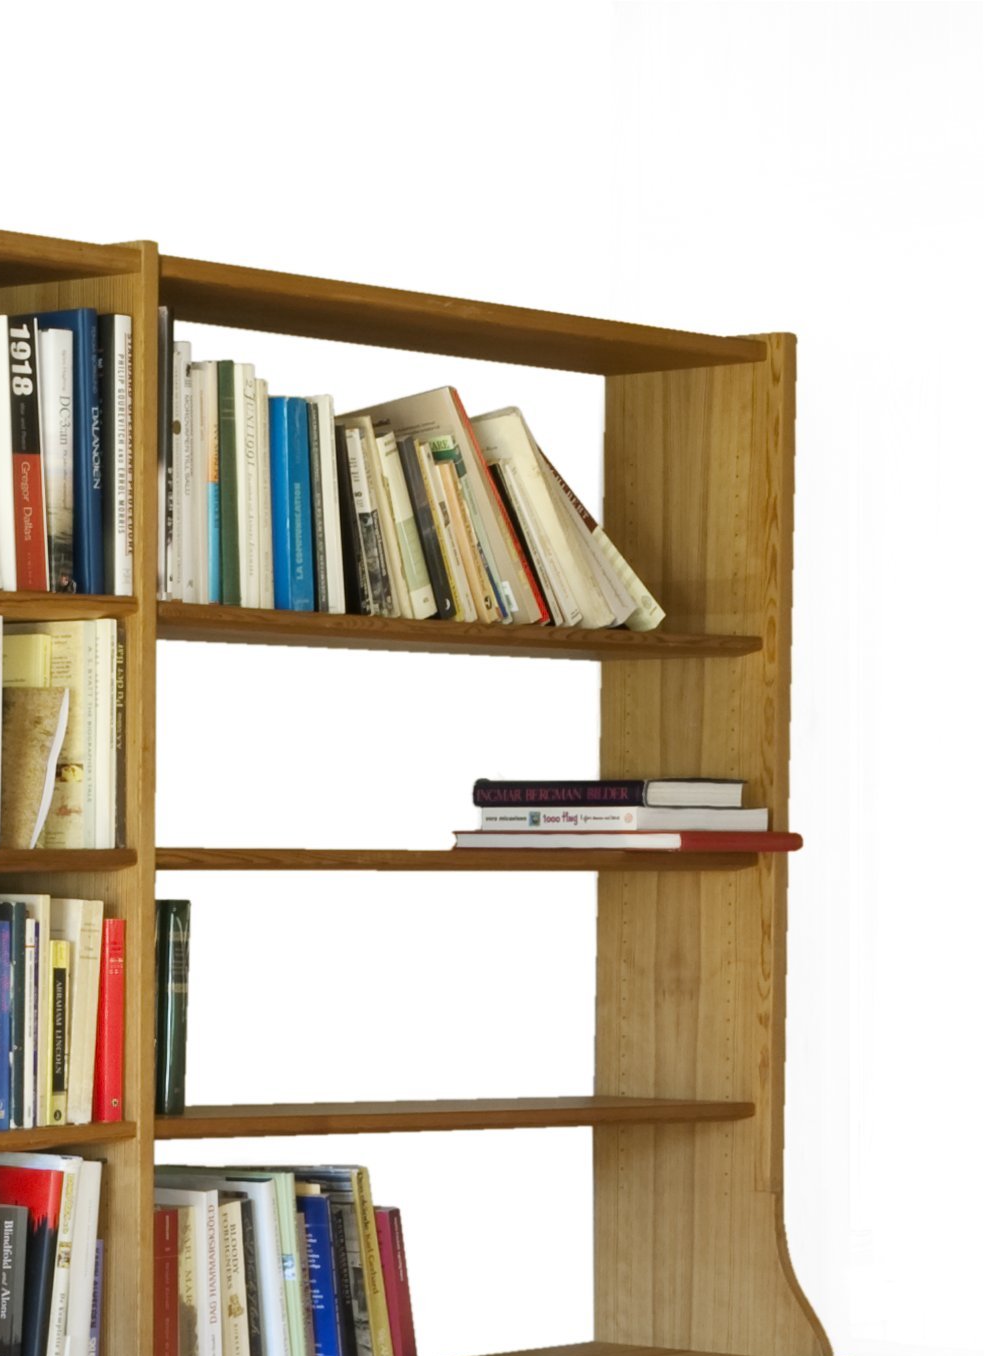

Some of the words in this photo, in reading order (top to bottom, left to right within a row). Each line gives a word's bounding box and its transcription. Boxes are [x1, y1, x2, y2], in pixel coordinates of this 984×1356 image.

[10, 323, 33, 396] 1918
[117, 353, 125, 385] PHILIP
[117, 388, 125, 444] GOUREVITCH
[20, 460, 32, 502] Gregor
[23, 506, 34, 541] Dallas
[118, 500, 126, 534] MORRIS
[54, 980, 63, 1026] ABRAHAM
[54, 1030, 63, 1074] LINCOLN
[1, 1219, 15, 1270] Blindfold
[206, 1204, 217, 1297] HAMMARSKJÖLD
[222, 1212, 233, 1291] FOREIGNERS
[230, 1223, 240, 1275] BLOODY
[0, 1287, 12, 1320] Alone
[208, 1300, 217, 1324] DAG
